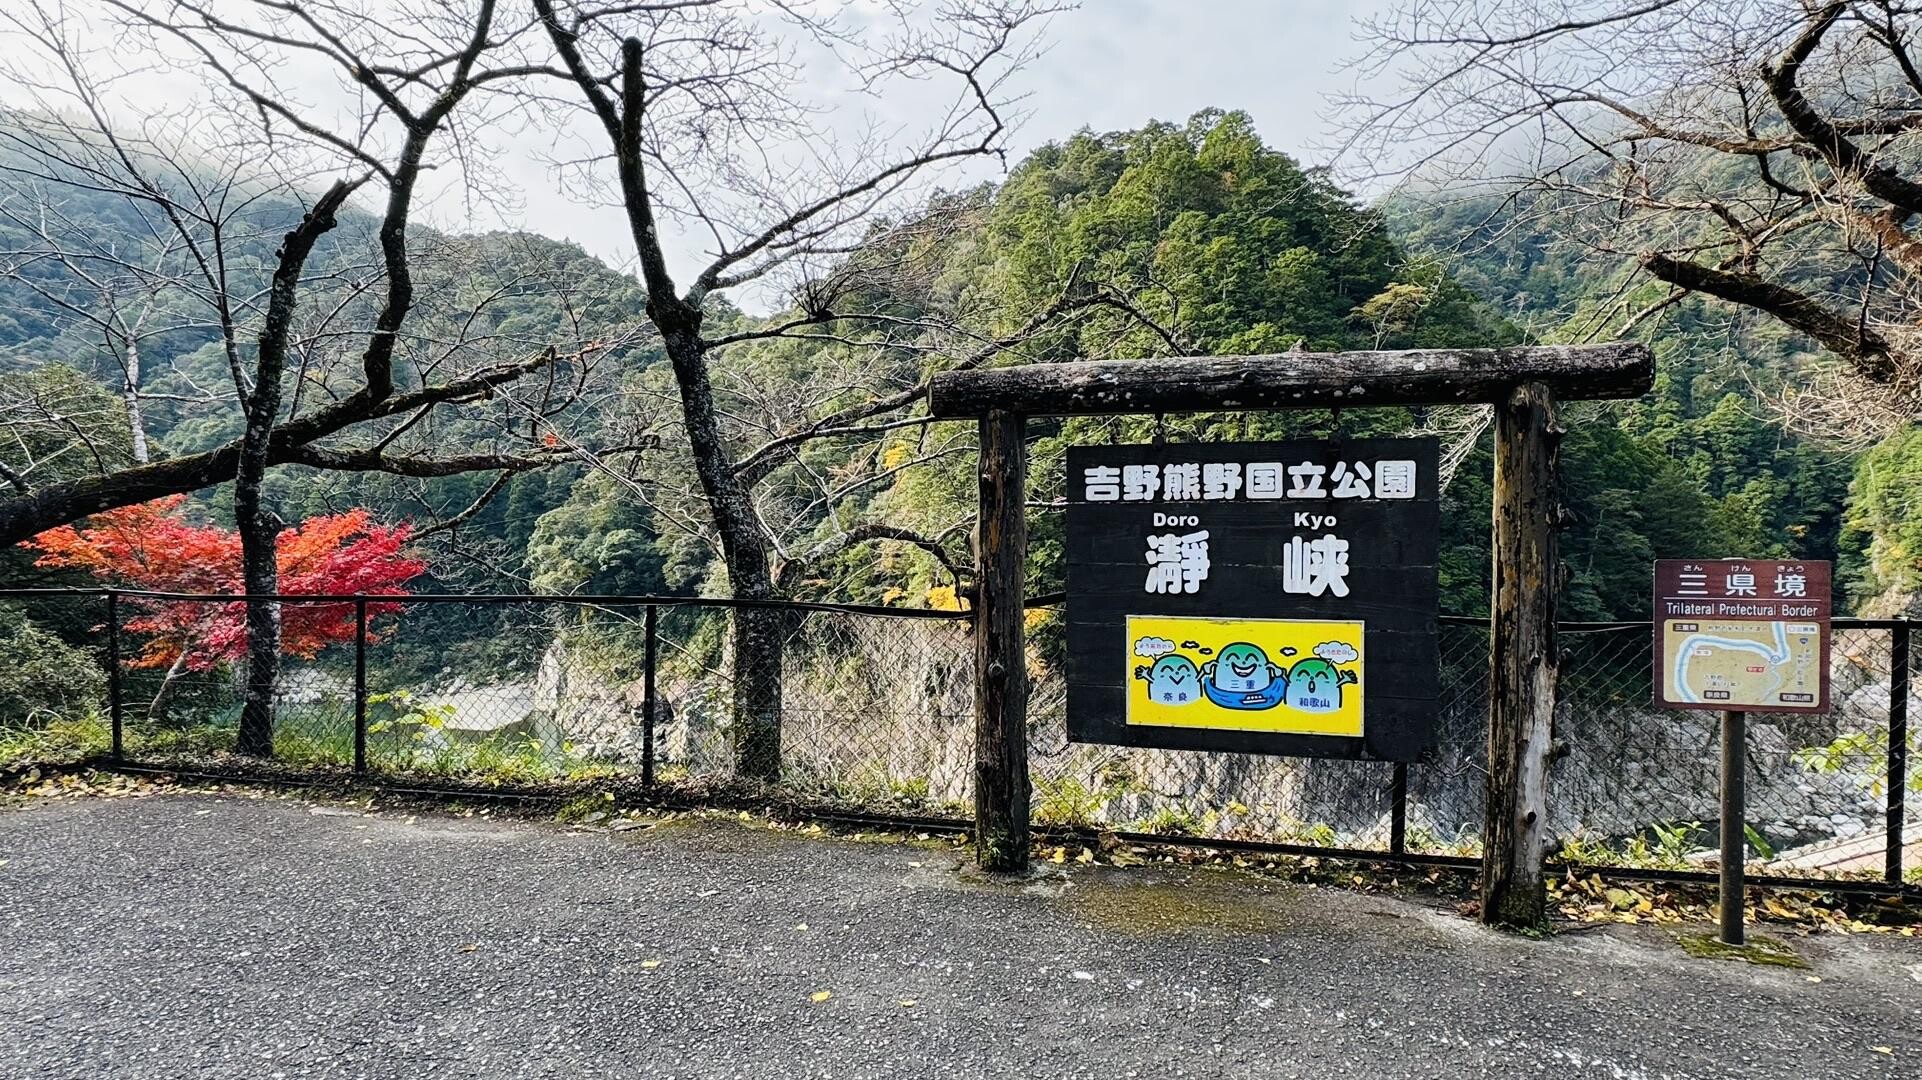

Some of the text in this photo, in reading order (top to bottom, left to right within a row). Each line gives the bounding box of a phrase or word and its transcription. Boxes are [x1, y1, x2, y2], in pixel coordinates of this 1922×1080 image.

[1084, 460, 1417, 501] 吉野熊野国立公園
[1153, 511, 1337, 530] Doro Kyo
[1666, 602, 1818, 617] Trilateral Prefectural Border
[1163, 692, 1187, 702] 奈良
[1299, 697, 1331, 708] 和歌山
